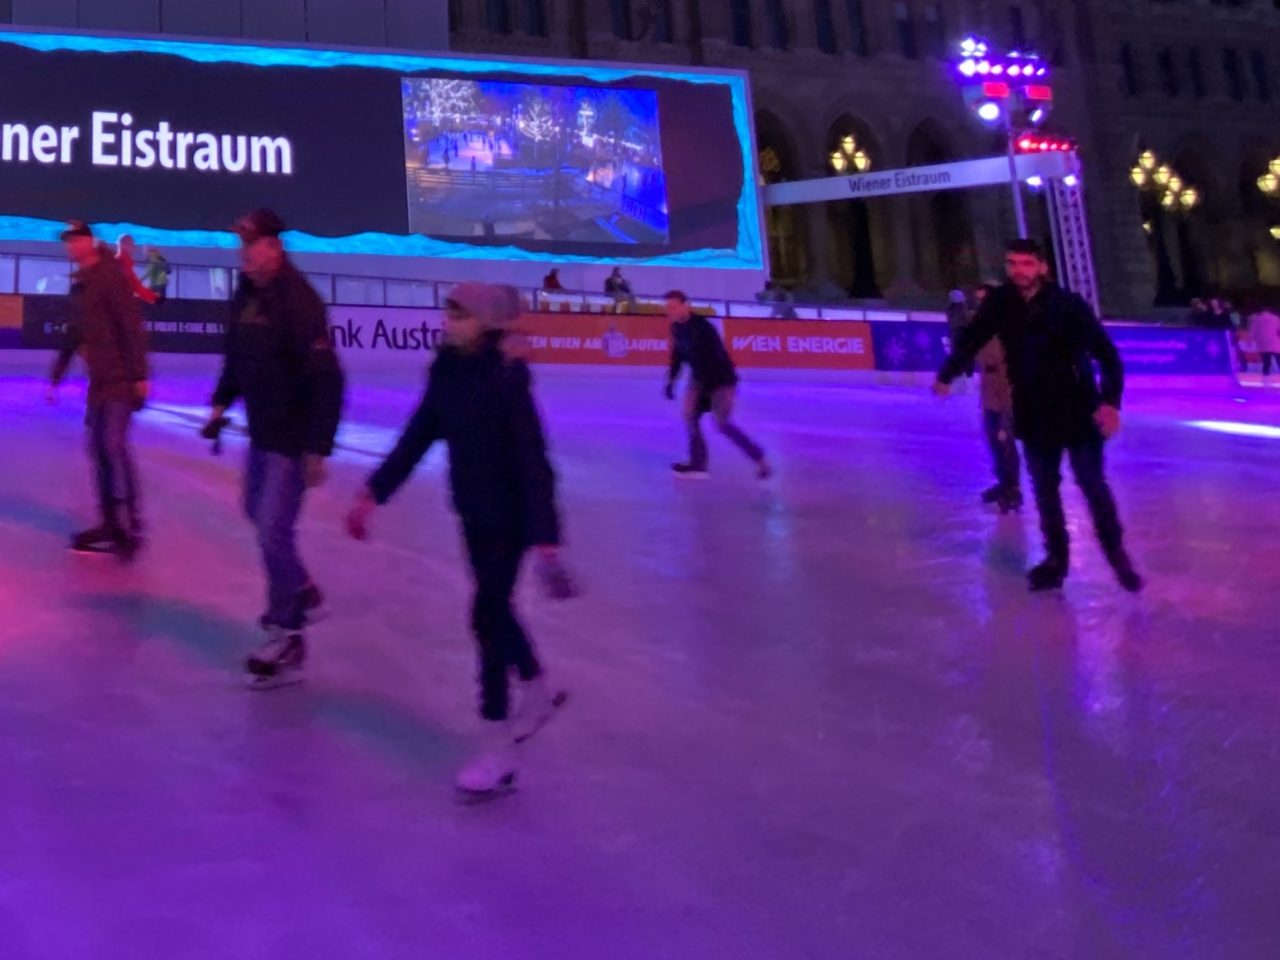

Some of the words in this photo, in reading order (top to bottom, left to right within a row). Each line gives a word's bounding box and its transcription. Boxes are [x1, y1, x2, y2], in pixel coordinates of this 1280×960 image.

[91, 111, 293, 175] Eistraum
[848, 177, 891, 193] Wiener
[894, 171, 951, 188] Eistraum
[330, 318, 364, 349] nk
[550, 336, 581, 349] WIEN
[732, 335, 781, 352] WIEN
[786, 336, 865, 354] ENERGIE
